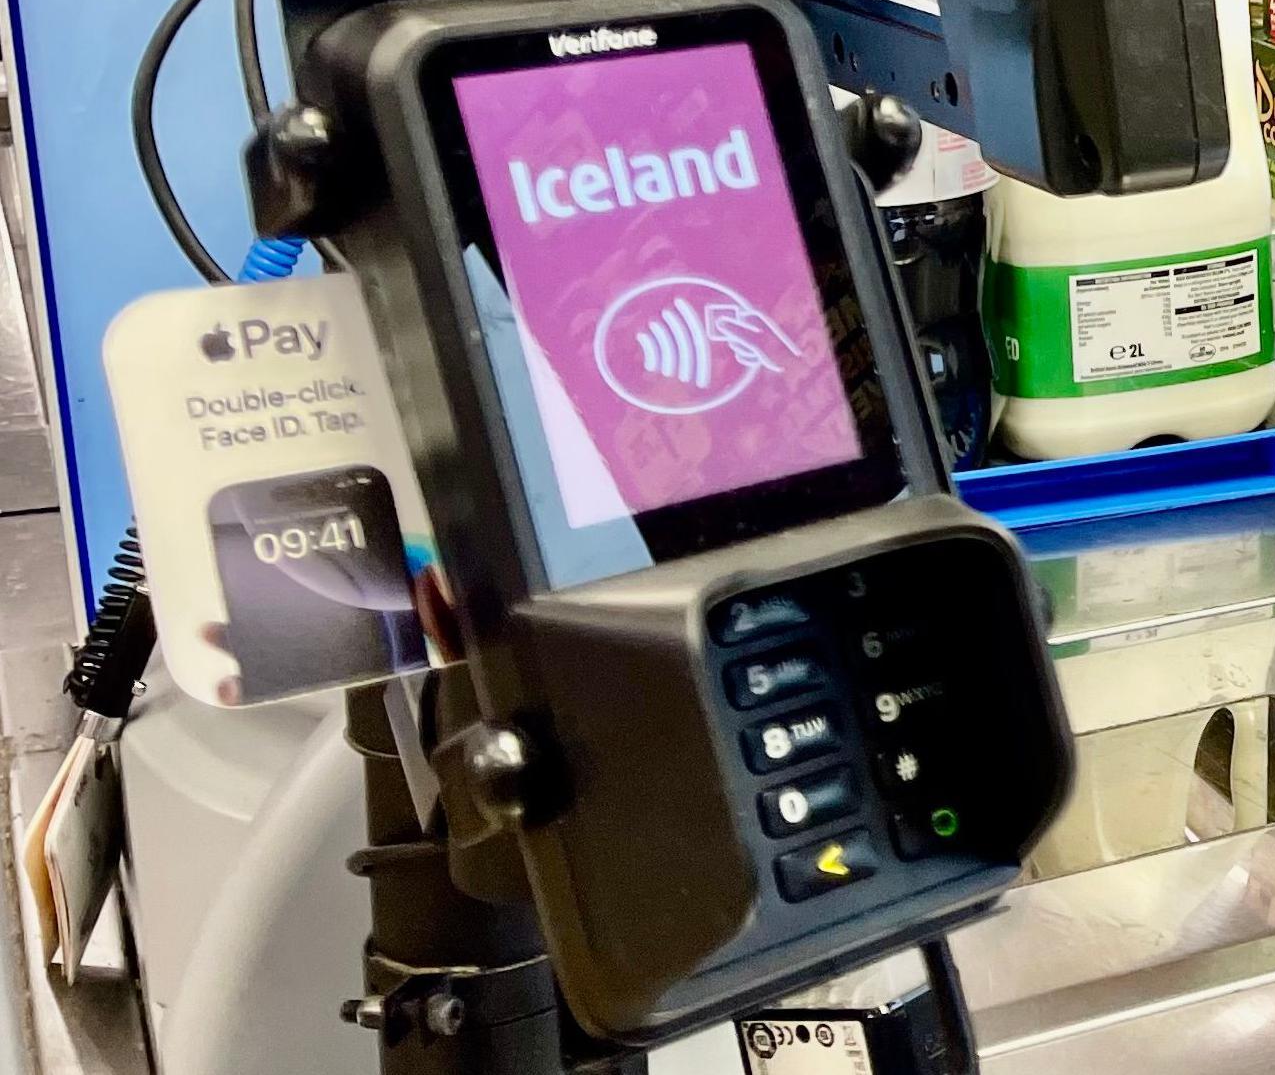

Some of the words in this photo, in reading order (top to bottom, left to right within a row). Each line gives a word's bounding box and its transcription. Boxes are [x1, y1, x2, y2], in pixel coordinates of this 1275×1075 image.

[548, 26, 658, 57] Verifone
[507, 127, 760, 224] Iceland
[238, 318, 329, 361] Pay
[1129, 343, 1145, 358] 2L
[185, 377, 366, 419] Double-click.
[200, 425, 267, 450] Face
[272, 416, 307, 439] ID.
[309, 409, 366, 435] Tap.
[254, 516, 367, 564] 09:41
[730, 602, 755, 632] 2
[862, 631, 883, 659] 6
[747, 664, 771, 695] 5
[875, 693, 900, 723] 9
[762, 726, 791, 759] 8
[778, 790, 809, 824] 0
